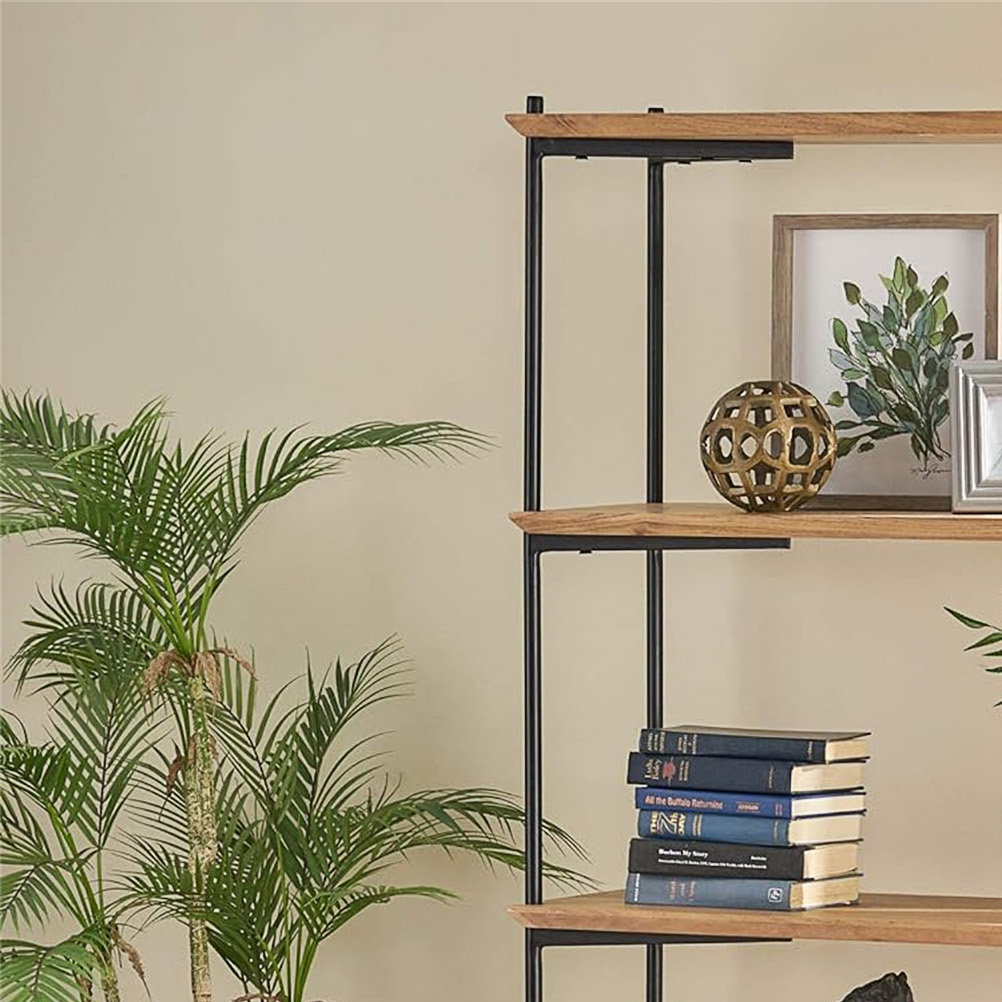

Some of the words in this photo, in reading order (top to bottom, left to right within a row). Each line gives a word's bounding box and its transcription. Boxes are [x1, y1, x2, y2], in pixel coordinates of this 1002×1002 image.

[645, 796, 655, 805] All
[656, 797, 666, 806] the
[667, 797, 691, 808] Buffalo
[691, 798, 723, 810] Returning
[650, 811, 659, 834] THE
